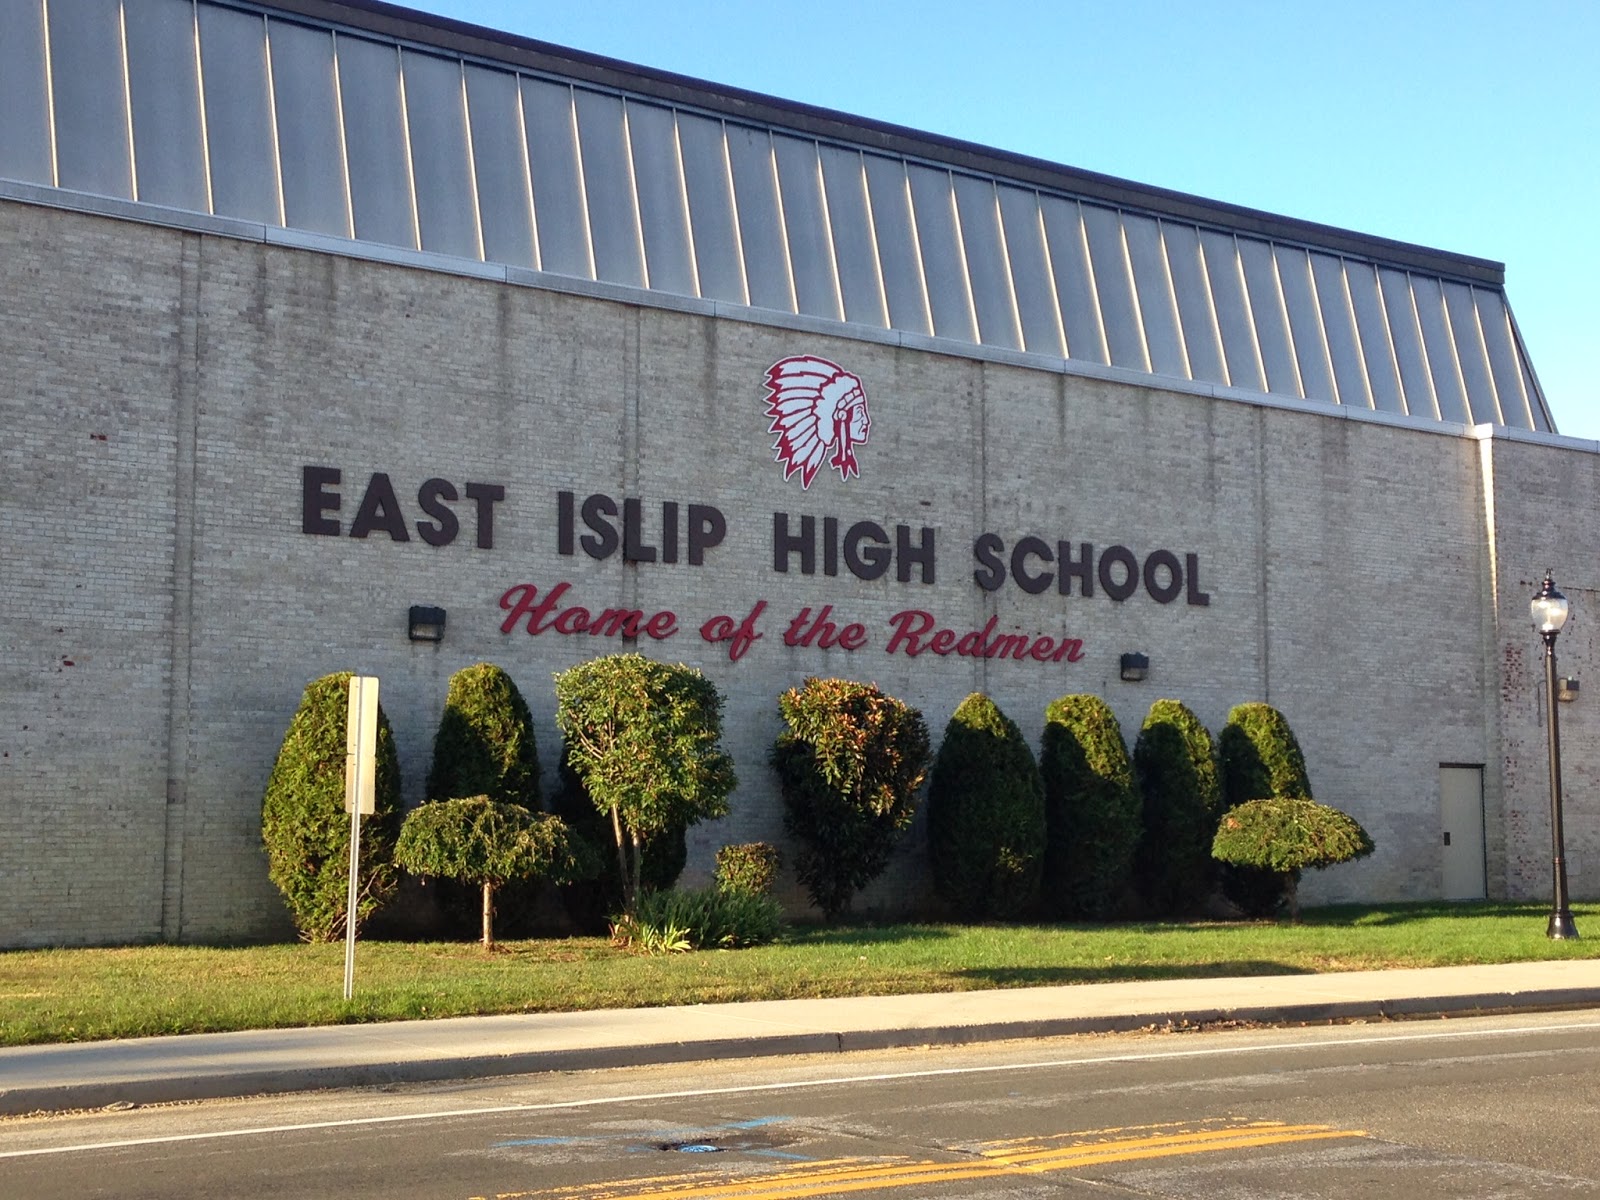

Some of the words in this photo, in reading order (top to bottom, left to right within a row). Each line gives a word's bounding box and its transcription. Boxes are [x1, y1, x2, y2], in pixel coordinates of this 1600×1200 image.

[302, 465, 505, 549] EAST
[557, 490, 727, 567] ISLIP
[773, 511, 936, 585] HIGH
[973, 532, 1210, 606] SCHOOL
[499, 582, 679, 640] Home
[700, 600, 767, 661] of
[783, 604, 868, 651] the
[885, 609, 1085, 663] Redmen
